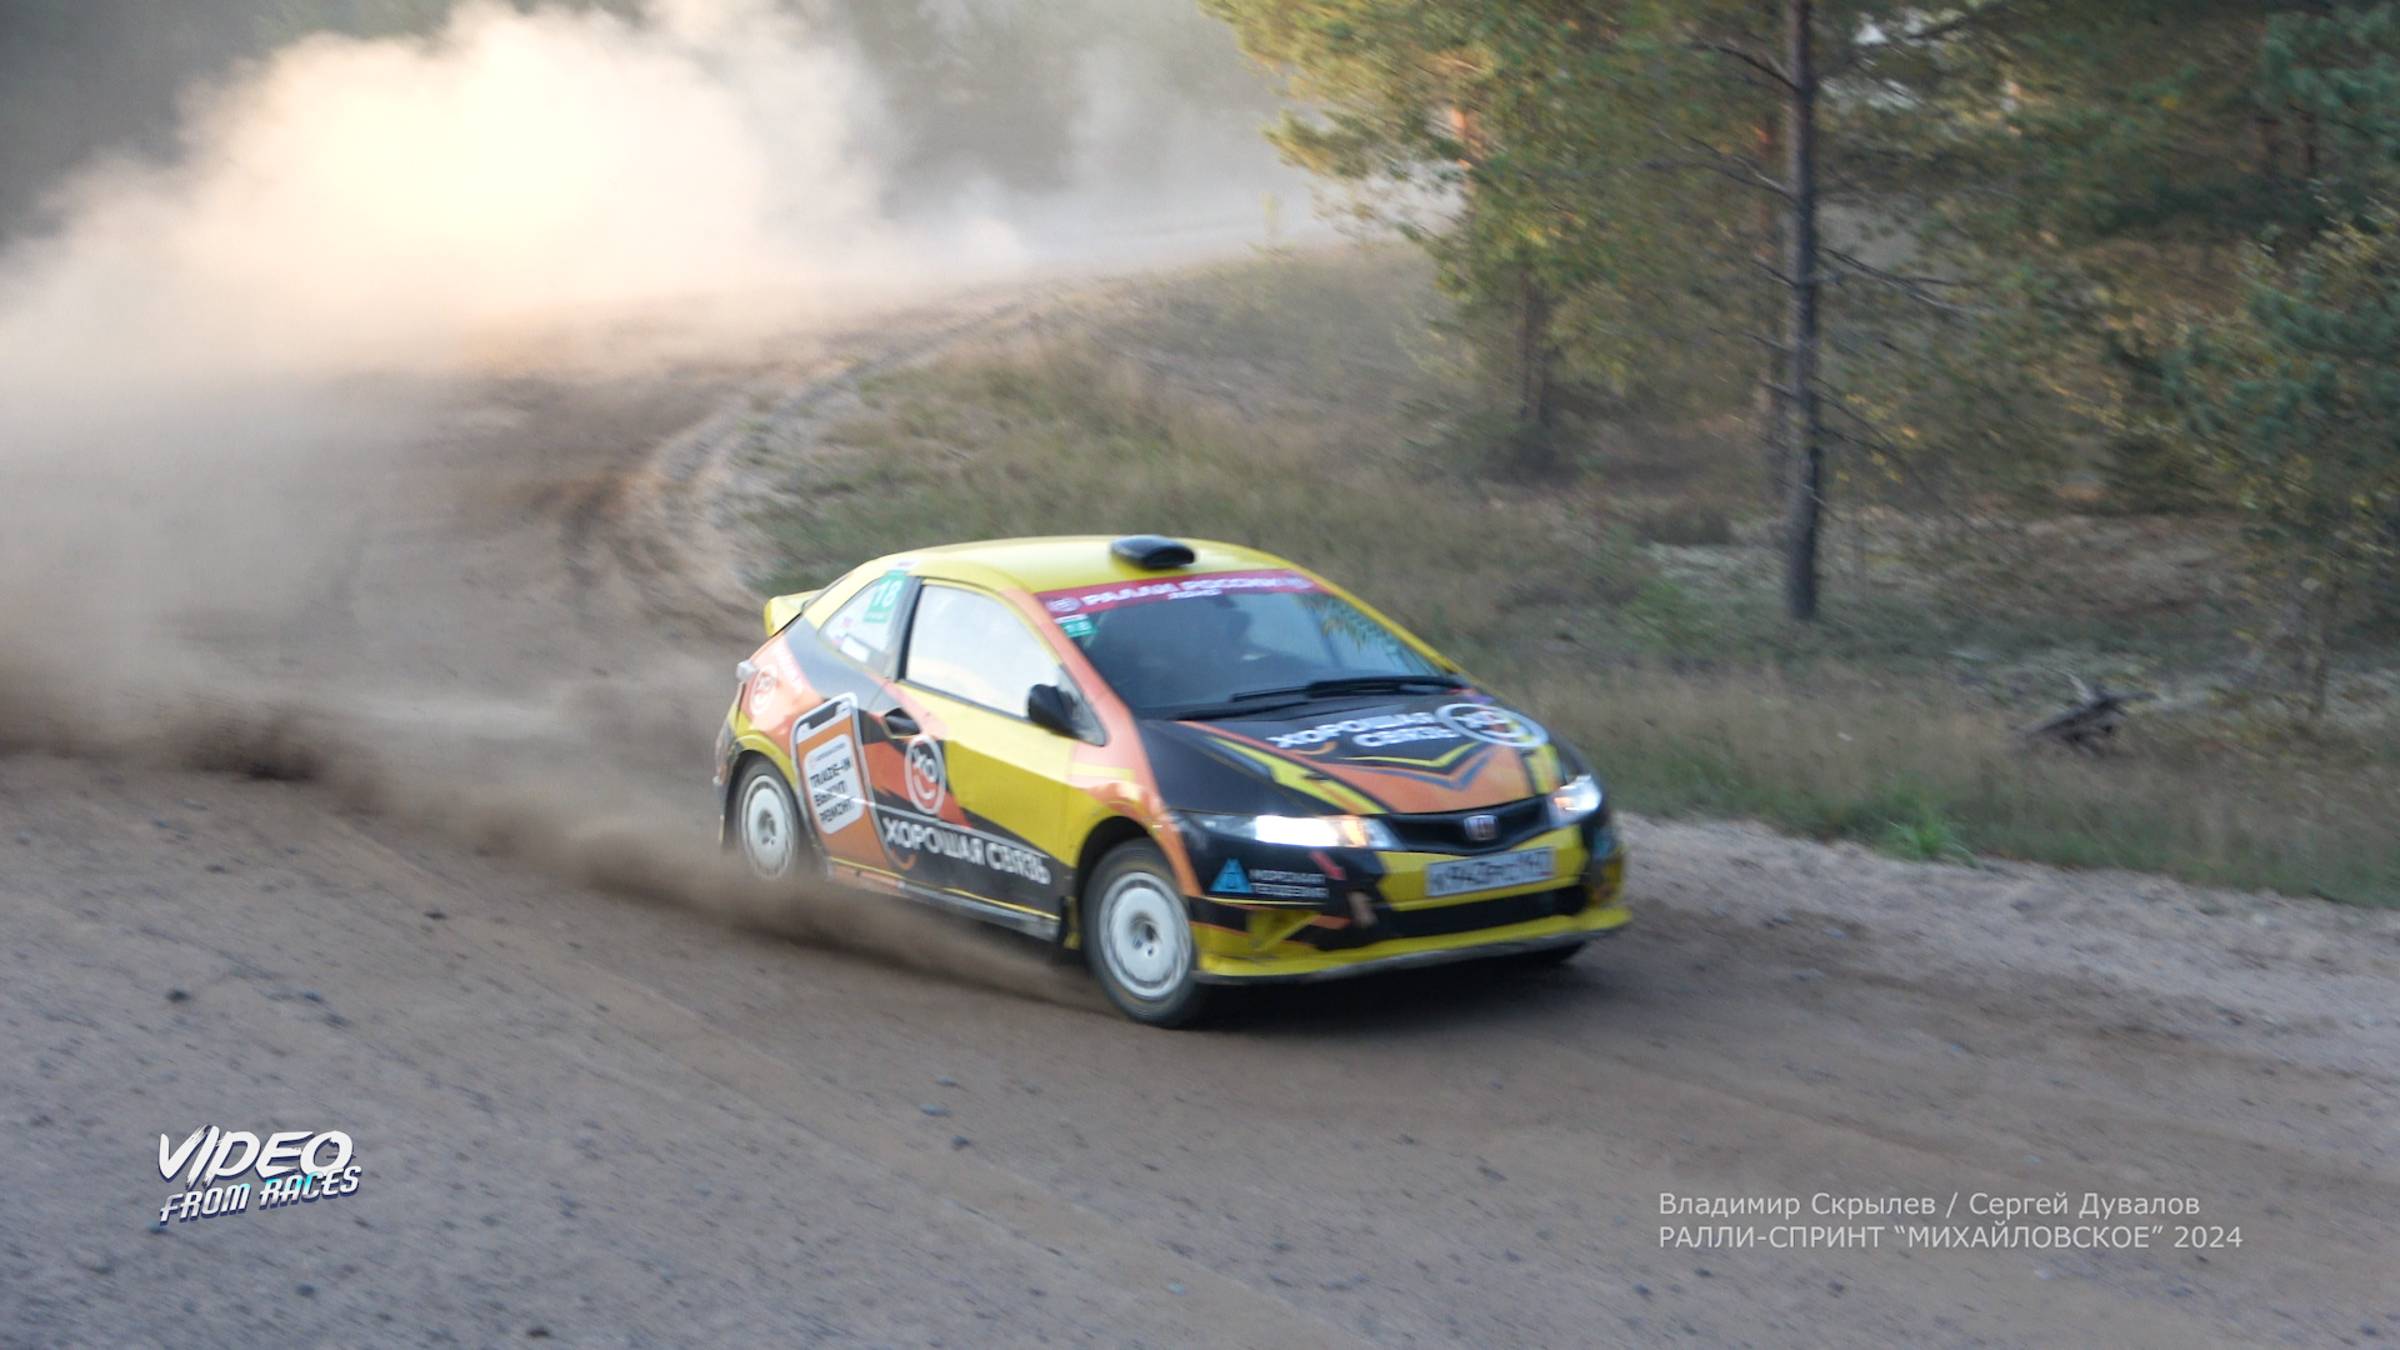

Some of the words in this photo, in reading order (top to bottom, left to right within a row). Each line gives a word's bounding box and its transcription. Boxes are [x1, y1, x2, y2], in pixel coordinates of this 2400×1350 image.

[871, 579, 903, 608] 18
[1266, 711, 1437, 748] ХОРОШАЯ
[882, 817, 986, 866] ХОРОШАЯ
[986, 842, 1051, 885] СВЯЗЬ
